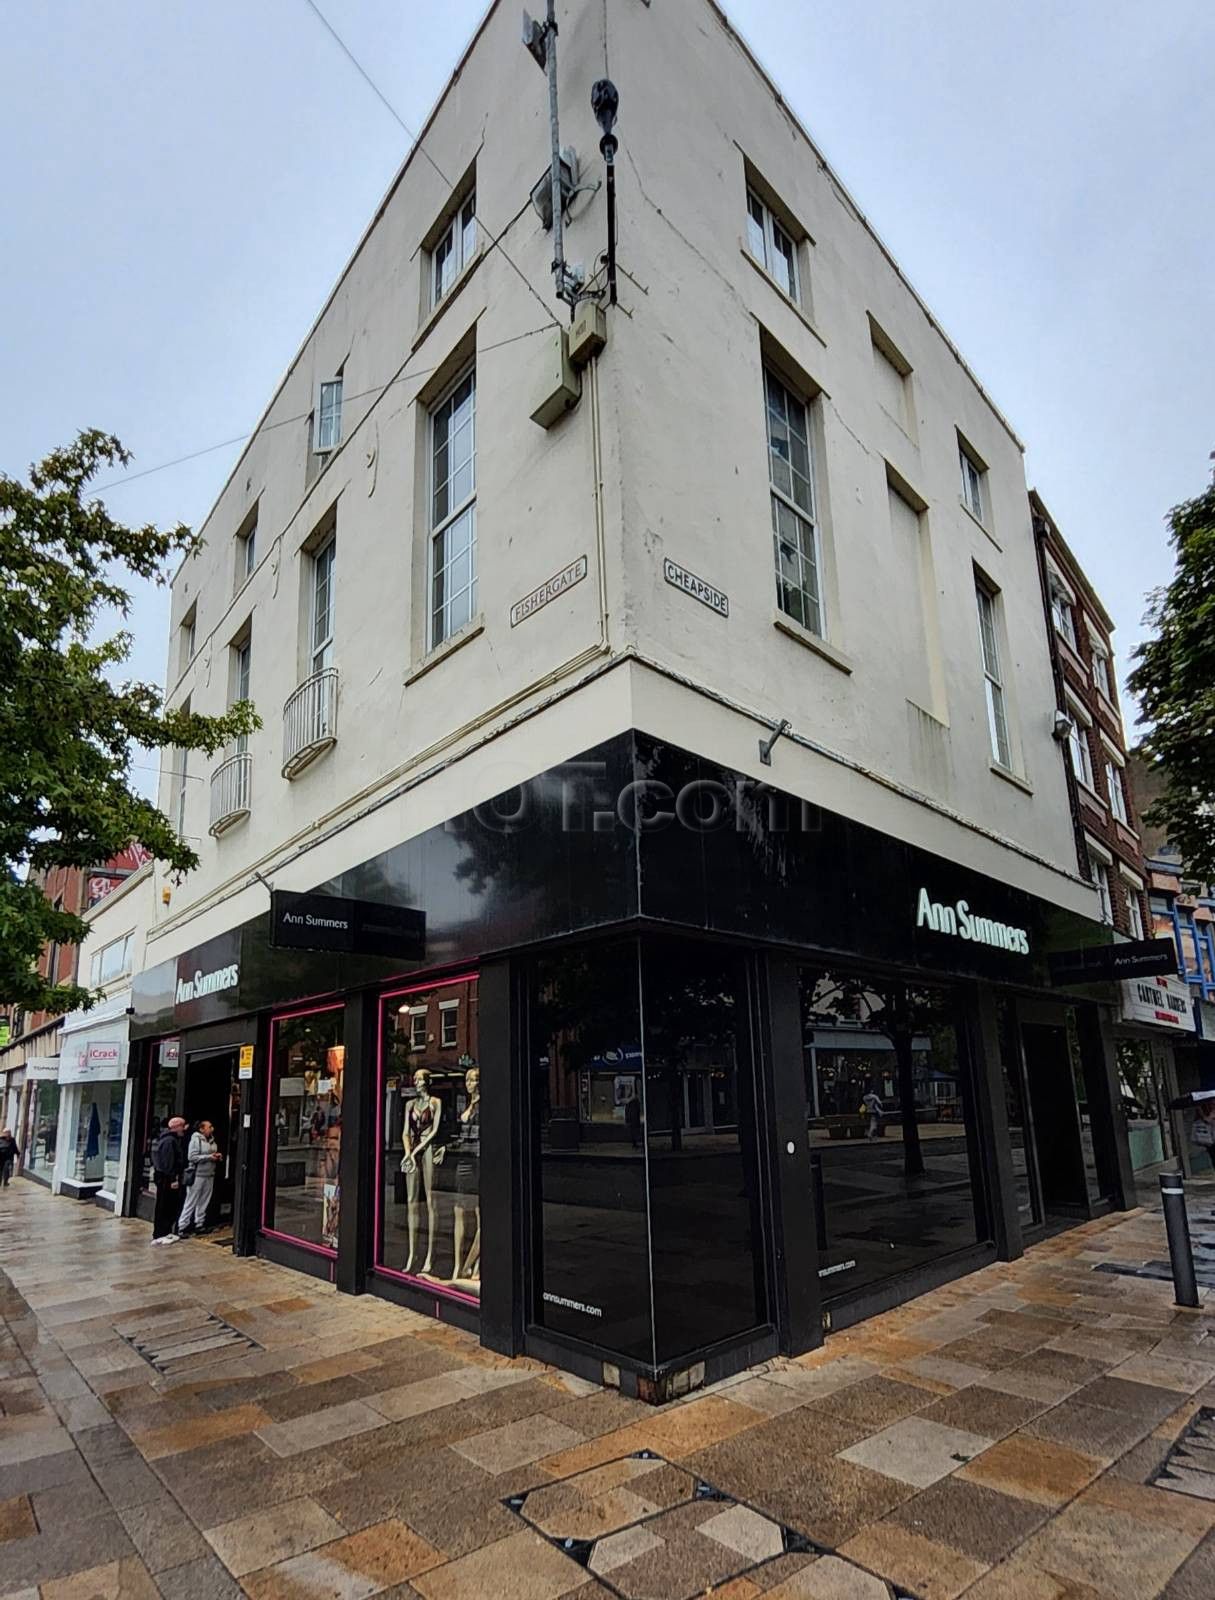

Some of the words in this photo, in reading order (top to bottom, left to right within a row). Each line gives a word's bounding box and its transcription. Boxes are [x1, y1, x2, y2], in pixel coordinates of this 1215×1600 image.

[514, 563, 582, 621] FISHERGATE
[667, 564, 726, 611] CHEAPSIDE
[282, 912, 304, 924] Ann
[305, 914, 349, 929] Summers
[917, 887, 957, 935] Ann
[956, 900, 1029, 955] Summers
[175, 977, 194, 1005] Ann
[193, 969, 239, 999] Summers
[89, 1049, 118, 1058] iCrack
[818, 1259, 856, 1278] nsummers.com
[542, 1291, 602, 1318] annsummers.com
